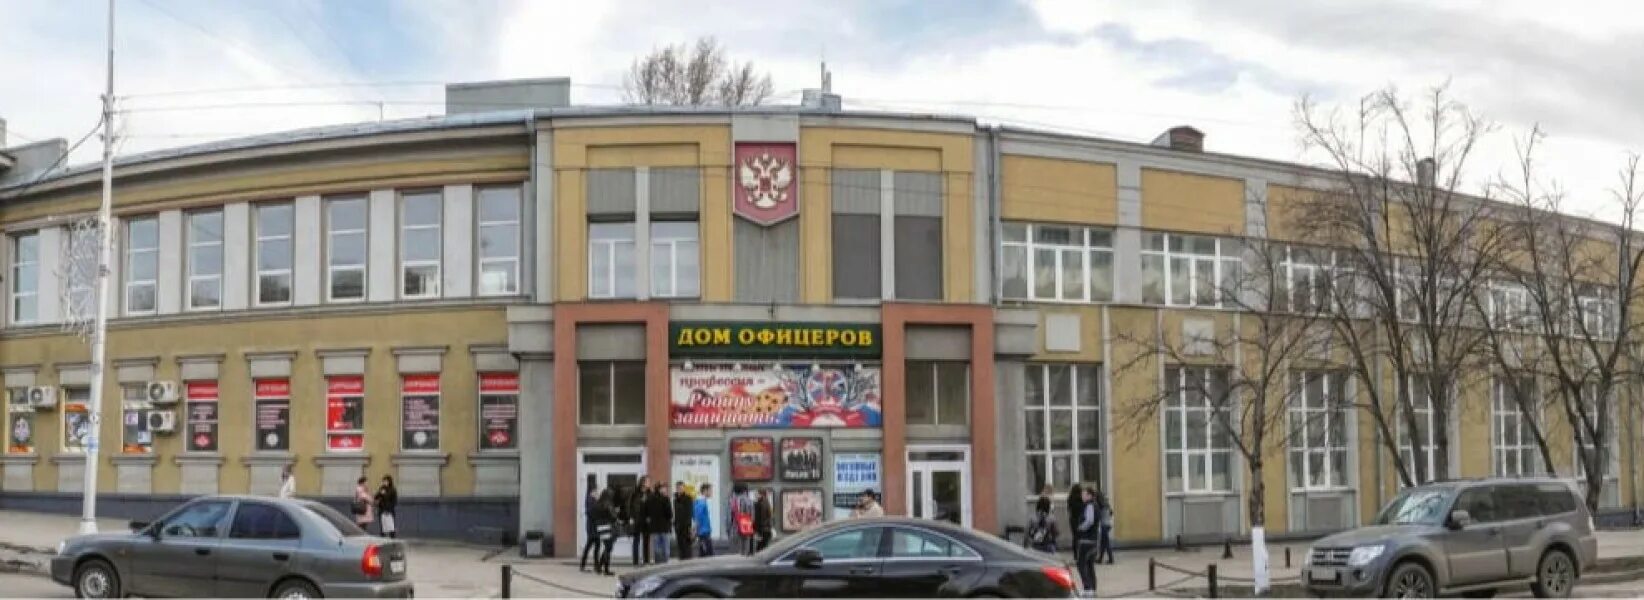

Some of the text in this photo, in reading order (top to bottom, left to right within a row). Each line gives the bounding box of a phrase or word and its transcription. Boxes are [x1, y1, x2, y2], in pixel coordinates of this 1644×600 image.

[677, 327, 873, 347] ДОМ ОФИЦЕРОВ
[679, 376, 753, 389] профессия
[689, 392, 756, 409] Родину
